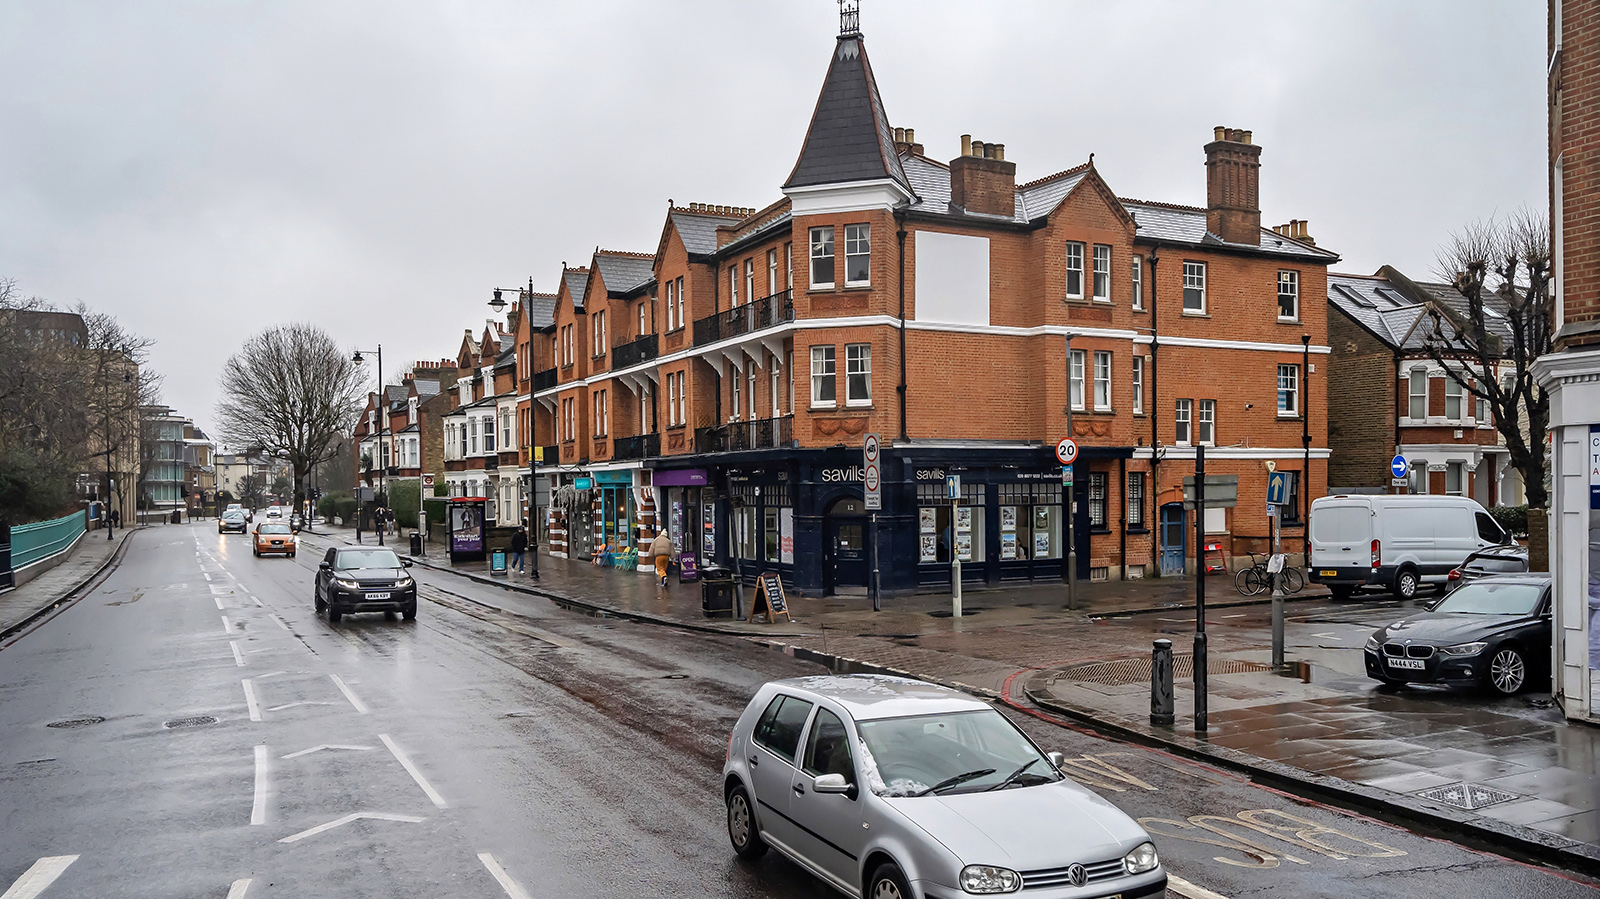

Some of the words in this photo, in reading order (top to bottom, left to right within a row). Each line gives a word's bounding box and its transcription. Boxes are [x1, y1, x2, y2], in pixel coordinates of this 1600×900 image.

[1059, 444, 1075, 456] 20
[821, 465, 866, 482] savills
[916, 467, 945, 480] savills
[1389, 660, 1407, 668] N444
[1407, 661, 1423, 669] VSL
